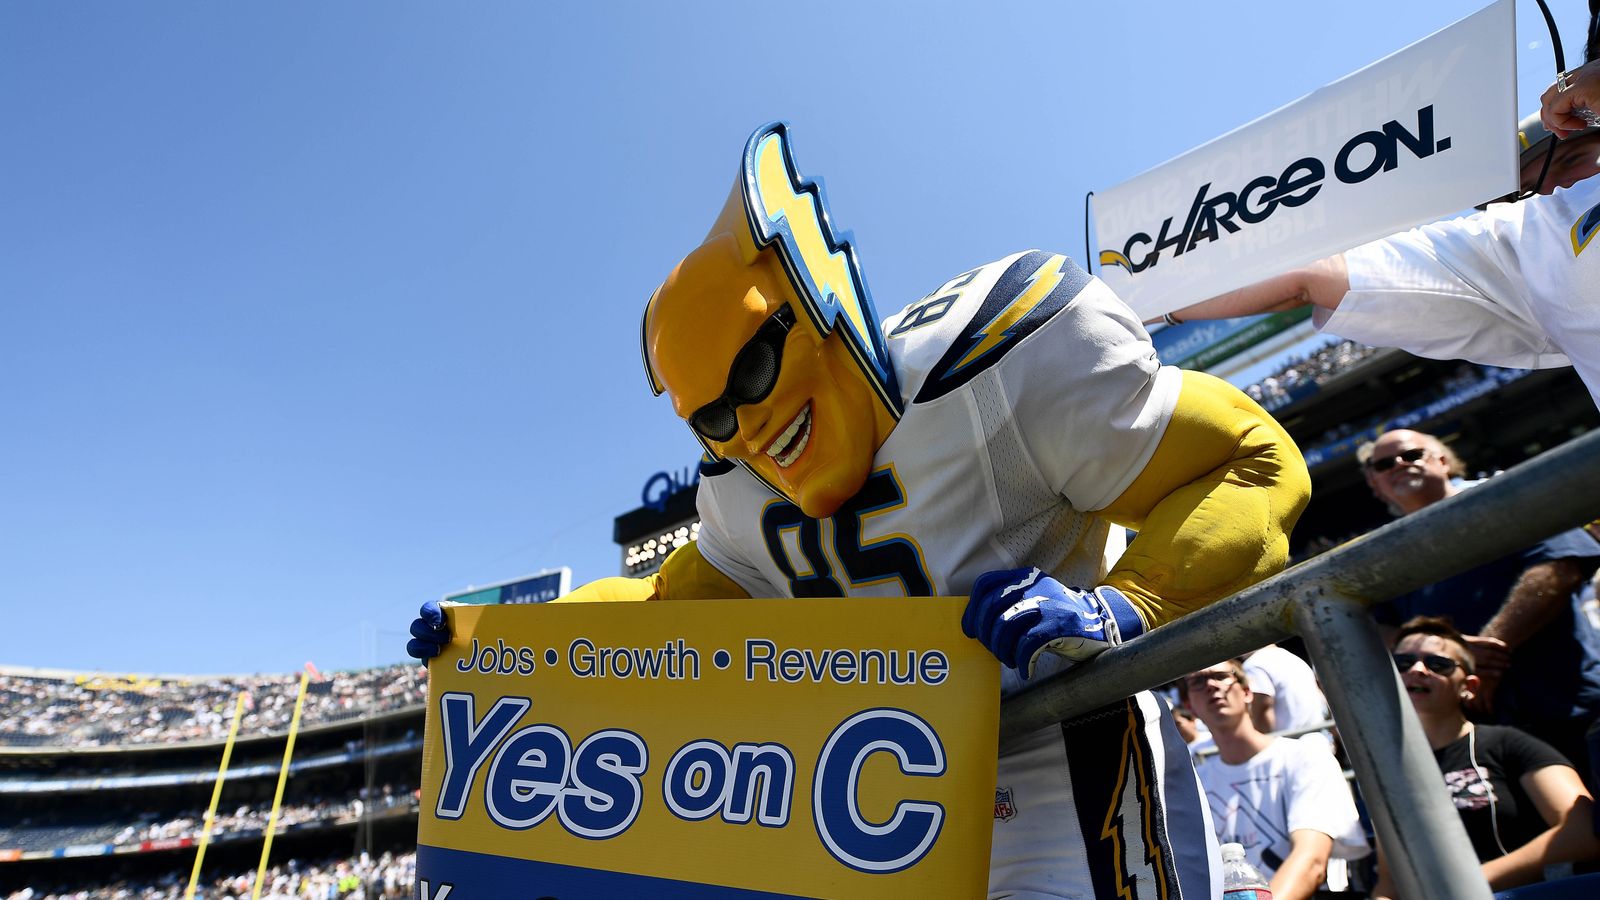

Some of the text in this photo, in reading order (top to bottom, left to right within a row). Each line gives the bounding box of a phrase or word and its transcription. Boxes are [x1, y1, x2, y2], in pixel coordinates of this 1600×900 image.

[1122, 103, 1452, 274] CHARGE ON.
[1164, 321, 1224, 360] eady.
[760, 462, 937, 598] 85
[456, 637, 951, 686] Jobs Growth Revenue
[435, 691, 948, 875] Yes on C
